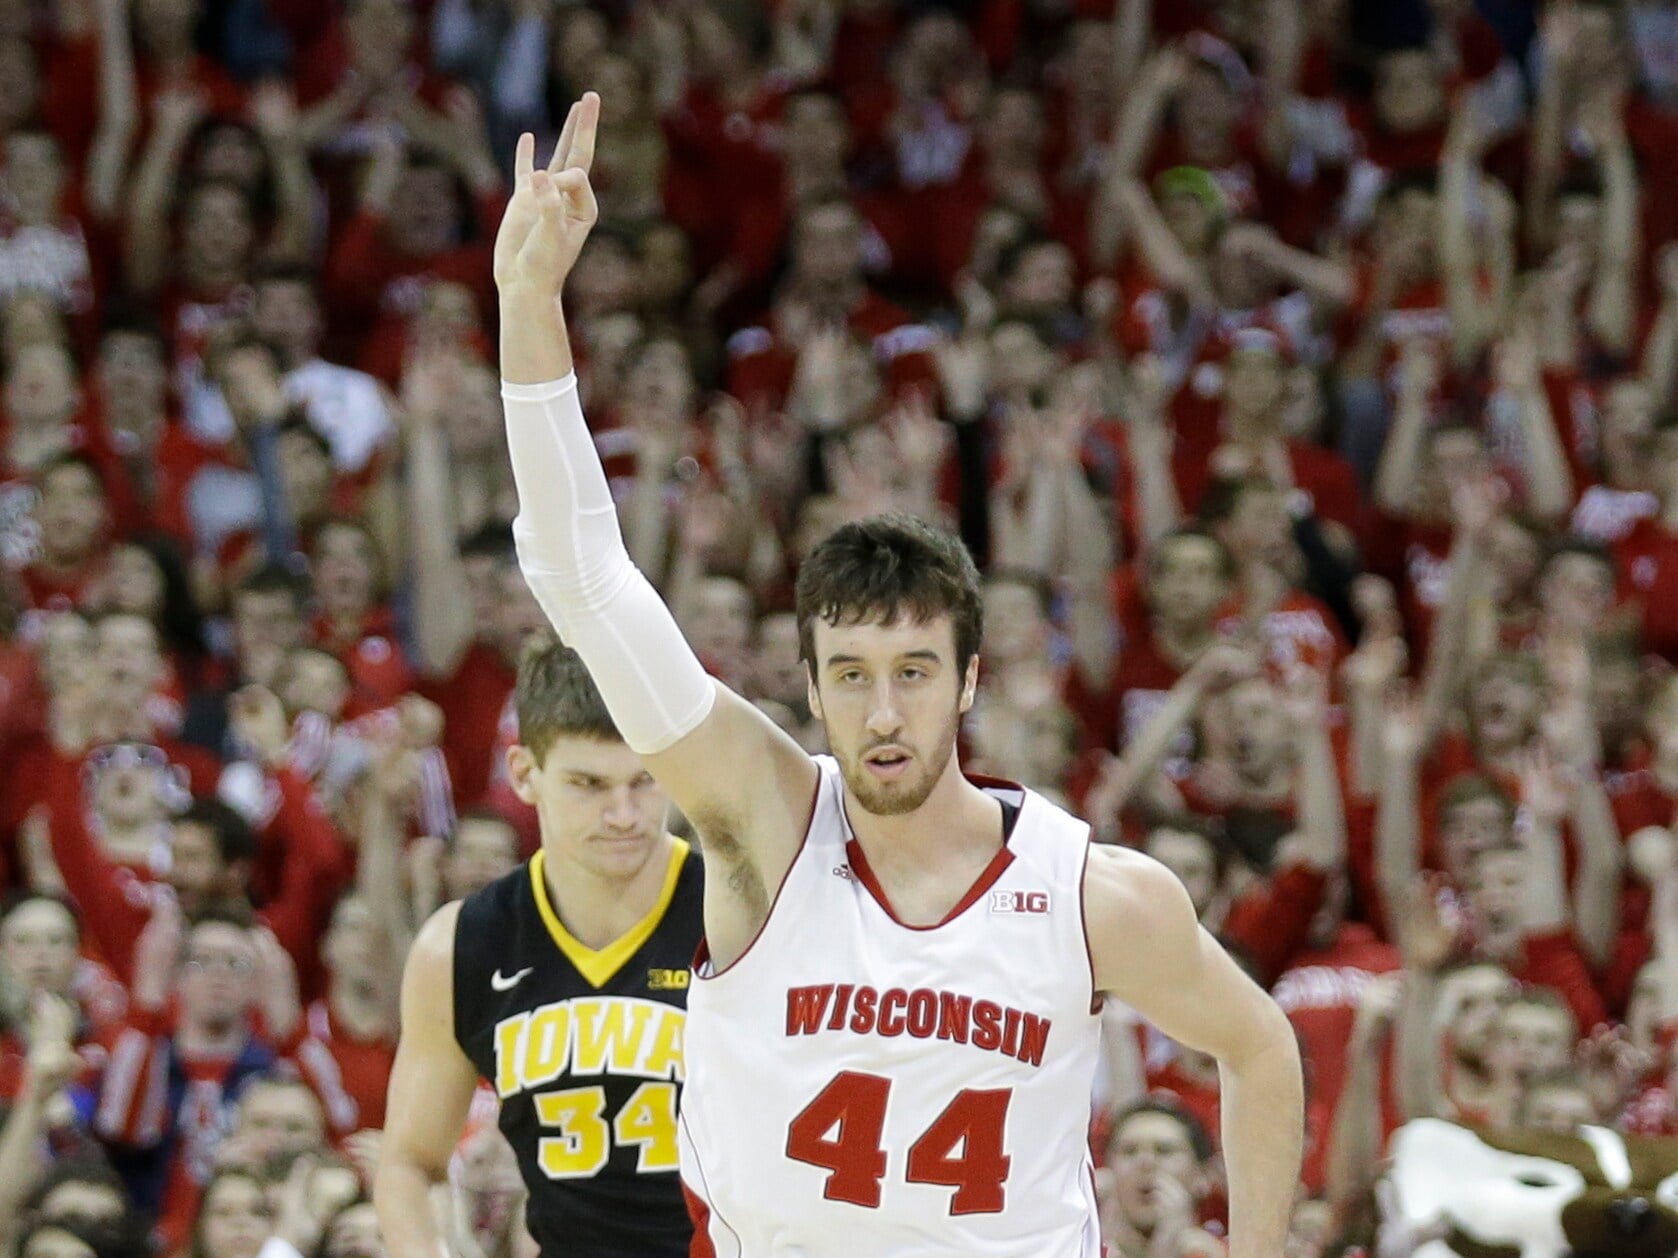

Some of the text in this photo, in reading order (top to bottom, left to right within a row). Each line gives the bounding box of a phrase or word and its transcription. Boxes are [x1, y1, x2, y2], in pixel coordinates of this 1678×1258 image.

[494, 996, 688, 1098] IOWA
[786, 984, 1051, 1067] WISCONSIN
[533, 1082, 680, 1178] 34
[785, 1069, 1013, 1216] 44
